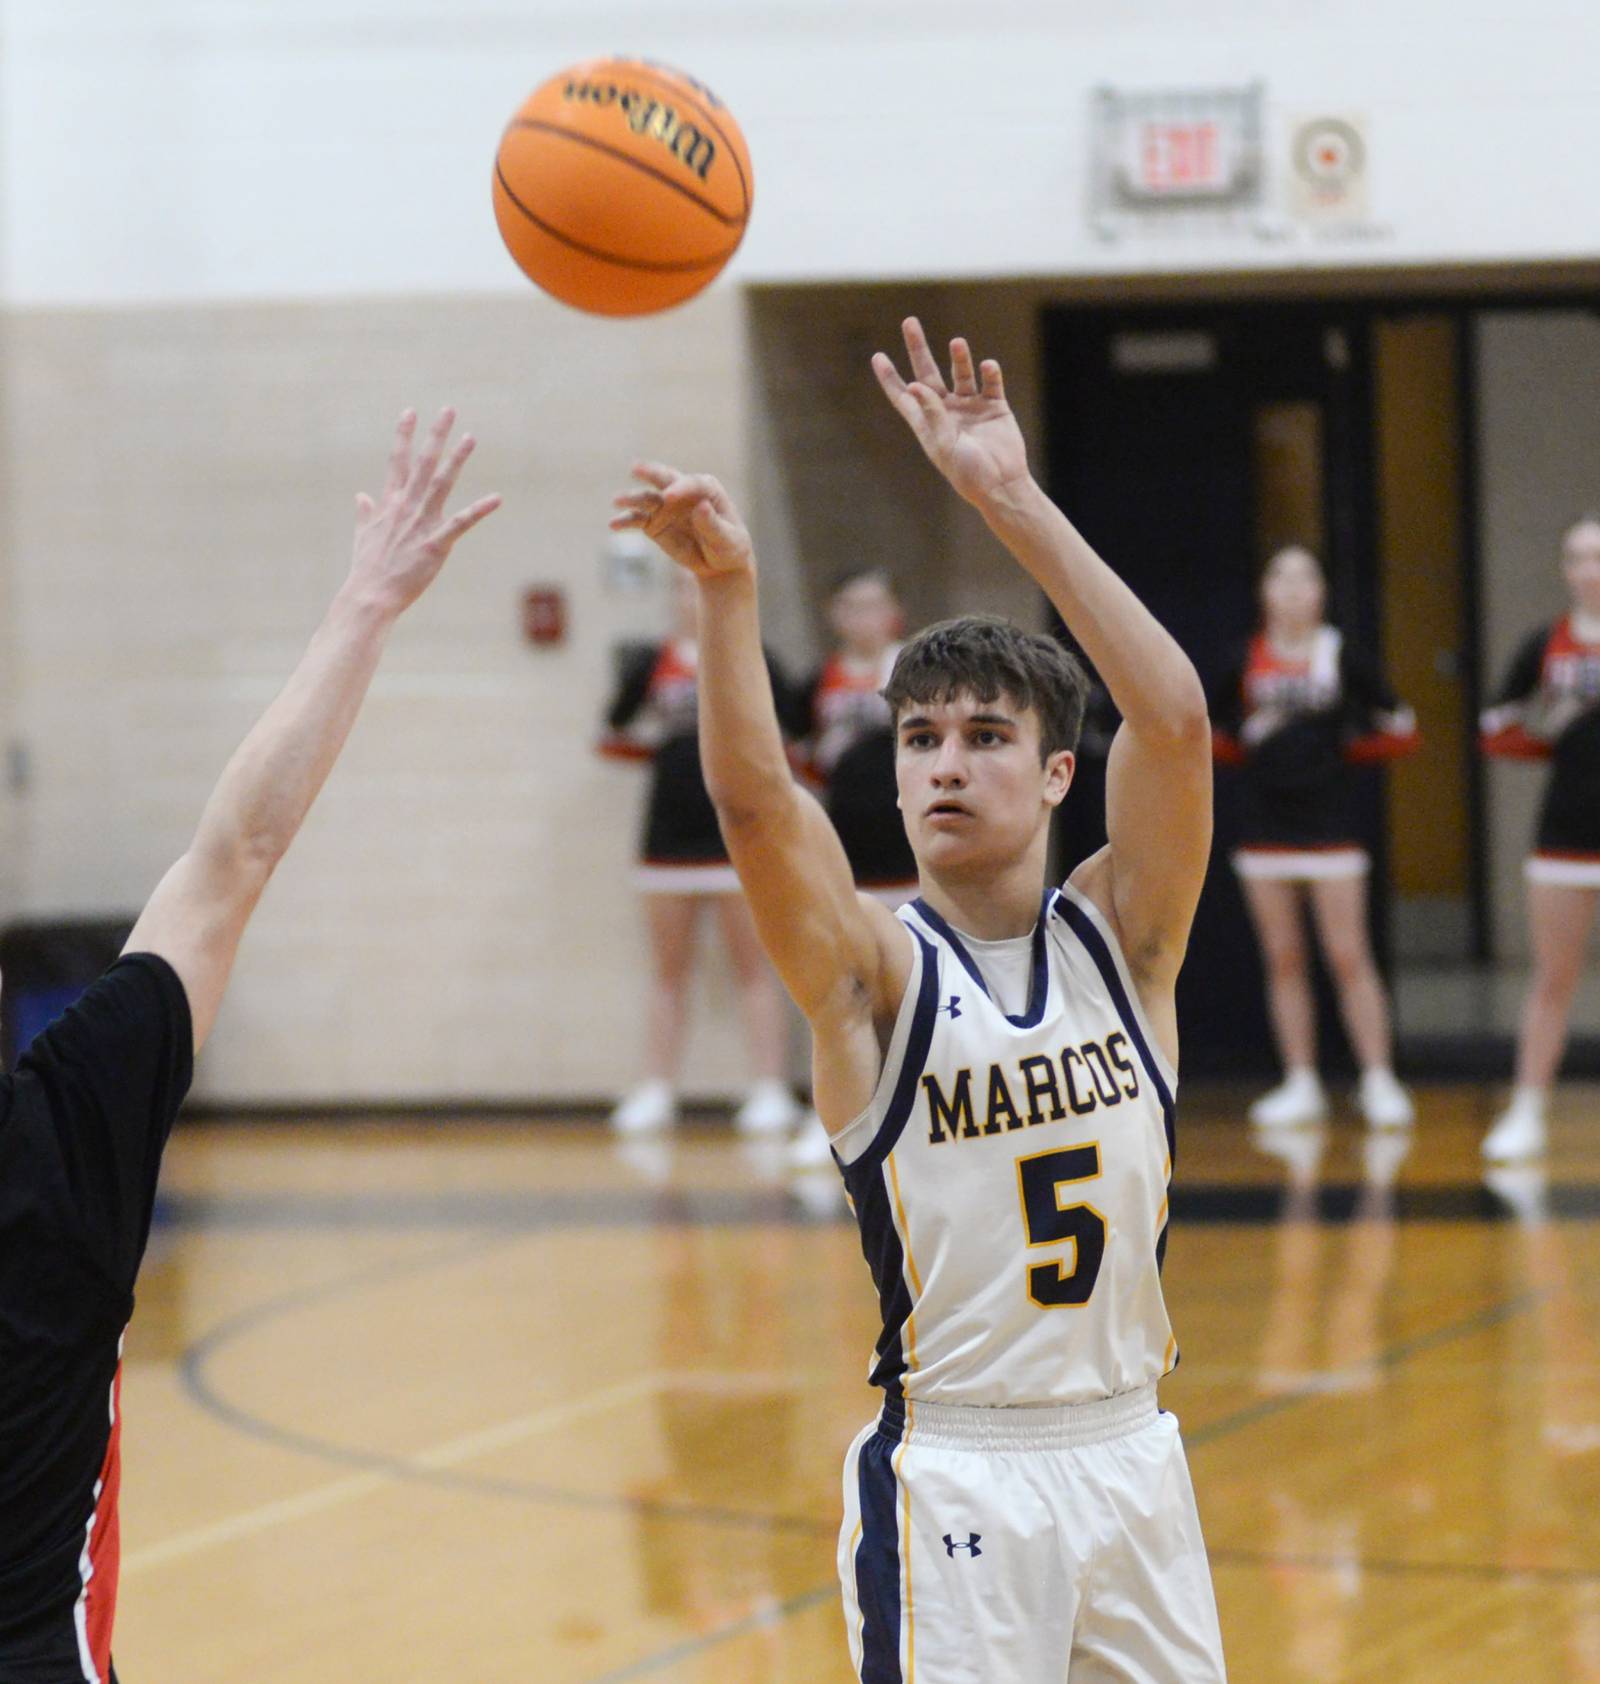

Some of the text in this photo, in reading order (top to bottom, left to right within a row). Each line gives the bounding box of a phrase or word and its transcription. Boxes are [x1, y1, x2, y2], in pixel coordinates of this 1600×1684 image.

[564, 79, 716, 180] Wilson
[922, 1031, 1139, 1145] MARCOS
[1015, 1140, 1109, 1310] 5
